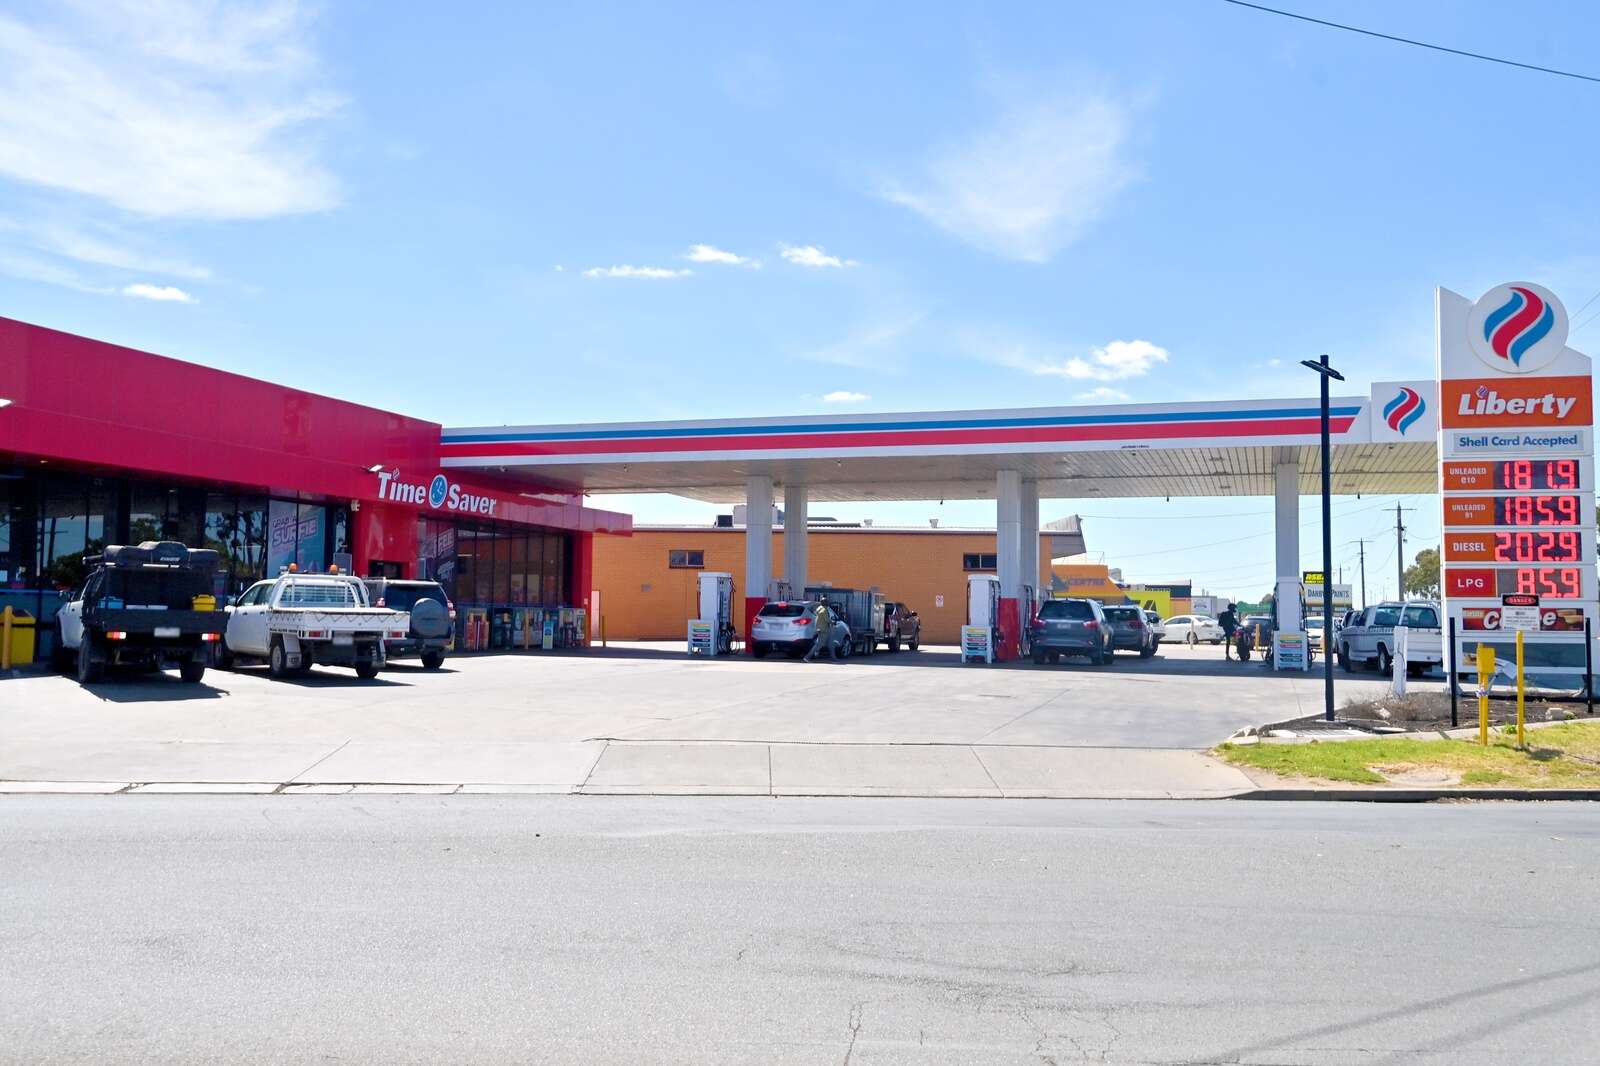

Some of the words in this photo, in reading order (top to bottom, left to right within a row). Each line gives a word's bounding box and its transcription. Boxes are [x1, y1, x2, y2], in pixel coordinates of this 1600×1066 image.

[1458, 386, 1577, 419] Liberty
[1459, 436, 1488, 447] Shell
[1491, 435, 1520, 446] Card
[1522, 434, 1578, 447] Accepted
[1449, 467, 1487, 475] UNLEADED
[1503, 459, 1576, 490] 181.9
[377, 468, 427, 504] Time
[447, 483, 497, 515] Saver
[1504, 496, 1576, 525] 185.9
[1453, 541, 1486, 552] DIESEL
[1494, 532, 1577, 562] 202.9
[1457, 578, 1484, 588] LPG
[1517, 567, 1579, 598] 85.9
